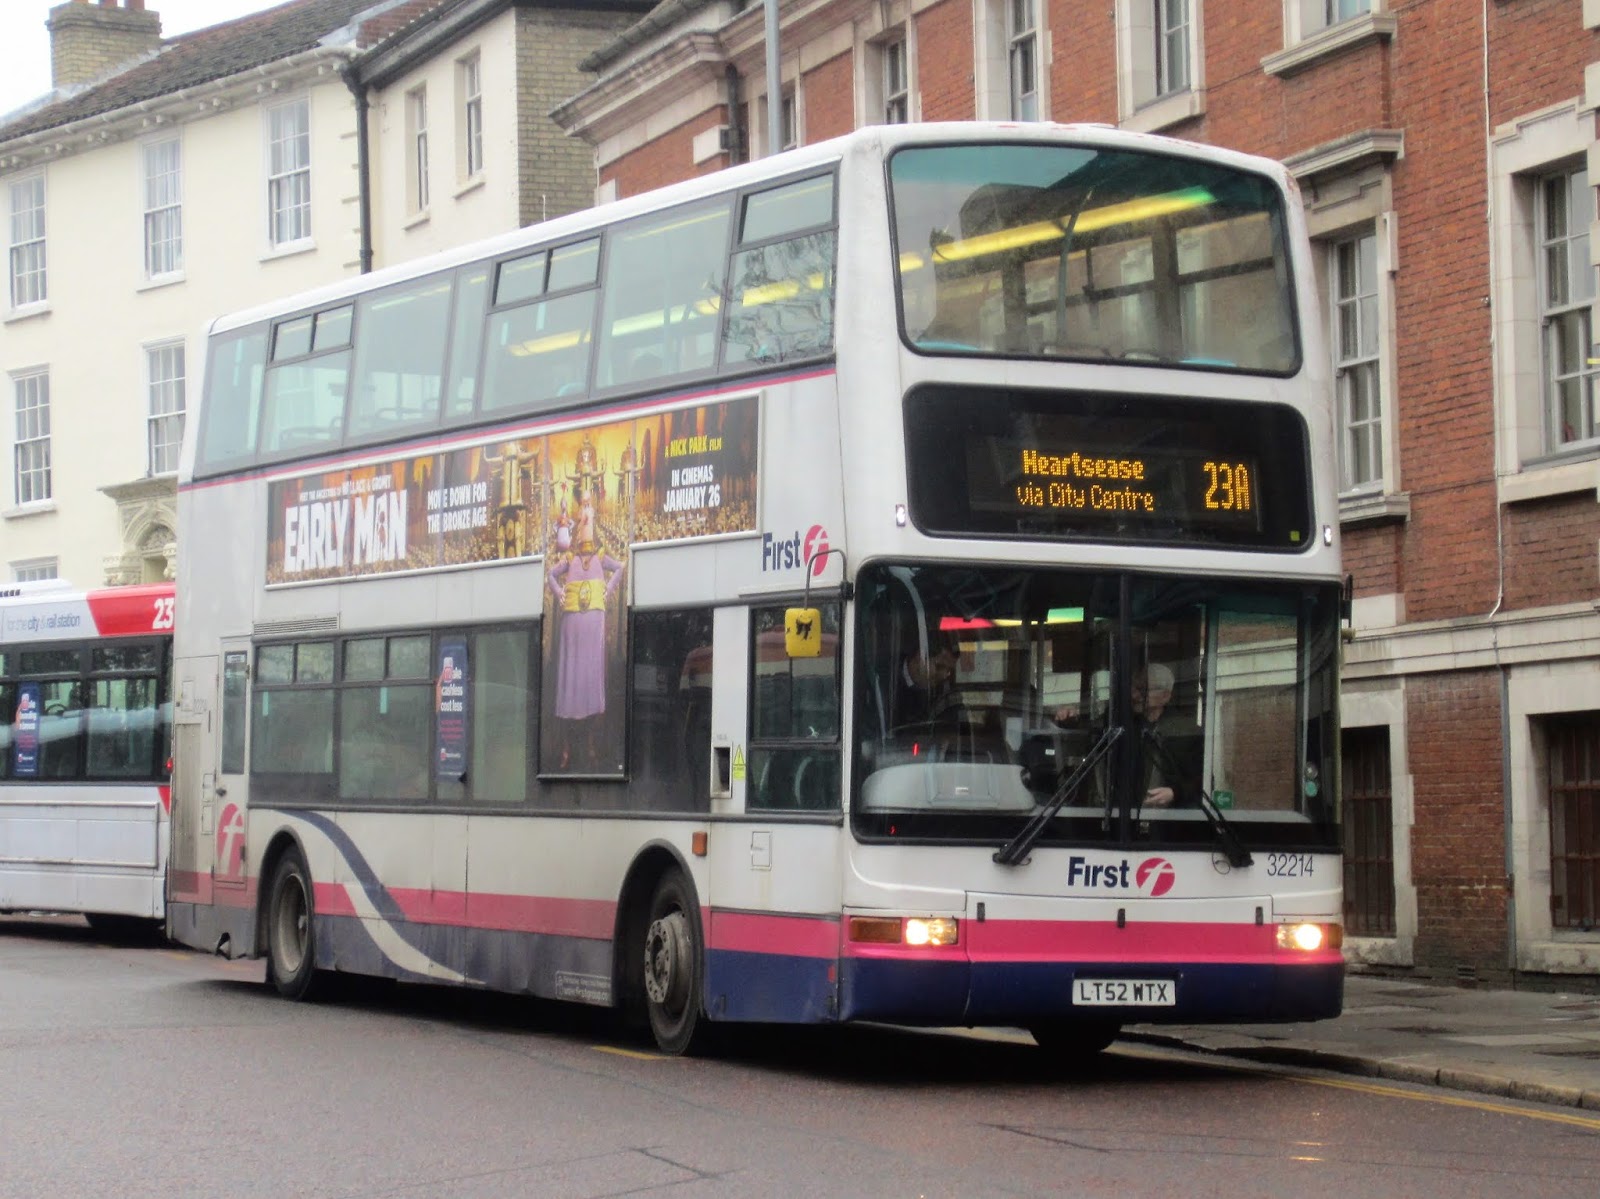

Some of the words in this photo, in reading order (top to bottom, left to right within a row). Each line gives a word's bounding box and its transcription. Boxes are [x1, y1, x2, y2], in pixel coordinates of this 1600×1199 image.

[670, 438, 687, 457] NICK
[688, 435, 708, 454] PARK
[671, 469, 680, 488] IN
[681, 464, 714, 486] CINEMAS
[1022, 449, 1145, 480] Heartsease
[449, 484, 471, 507] DOWN
[472, 481, 487, 503] FOR
[663, 485, 707, 512] JANUARY
[708, 484, 721, 507] 26
[1016, 481, 1045, 507] via
[1048, 482, 1086, 509] City
[1089, 483, 1155, 512] Centre
[1202, 461, 1251, 511] 23A
[283, 498, 349, 573] EARLY
[352, 489, 408, 566] MAN
[427, 513, 440, 534] THE
[442, 509, 471, 533] BRONZE
[472, 506, 488, 528] AGE
[762, 530, 801, 572] First
[1067, 856, 1130, 889] First
[1266, 853, 1315, 877] 32214
[1079, 982, 1128, 1002] LT52
[1132, 982, 1169, 1002] WTX
